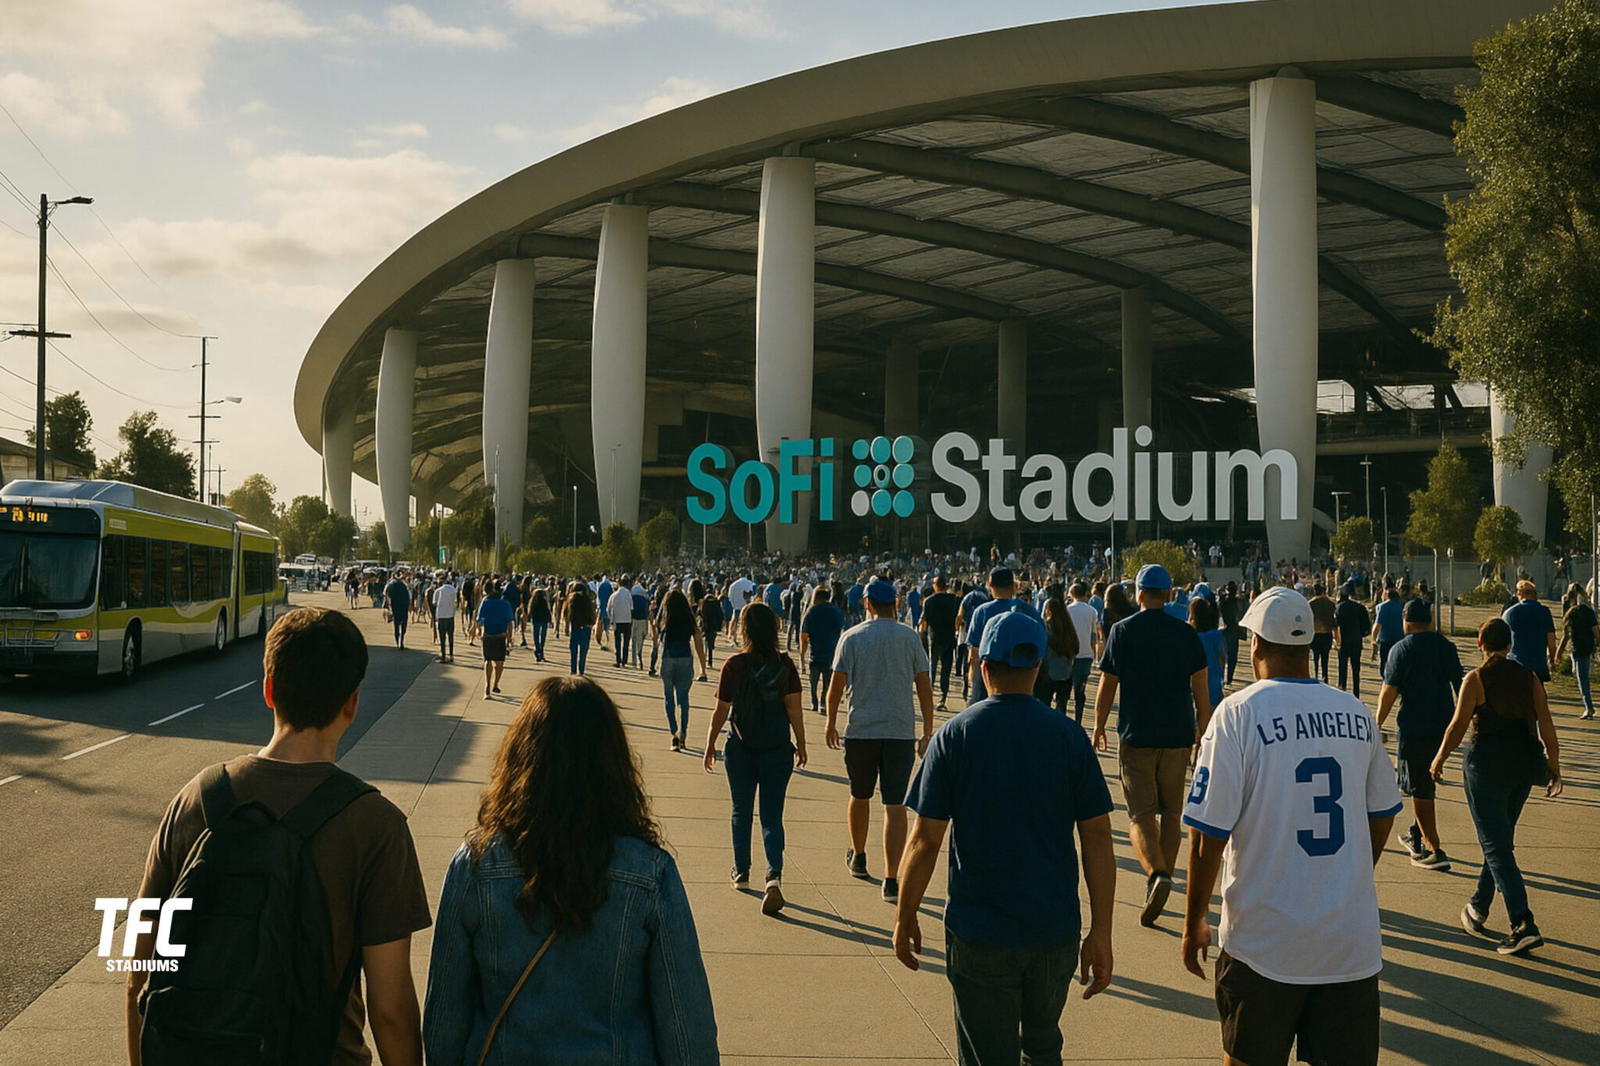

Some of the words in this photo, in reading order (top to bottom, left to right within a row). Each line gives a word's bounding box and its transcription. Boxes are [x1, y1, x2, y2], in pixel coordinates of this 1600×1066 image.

[686, 437, 834, 525] SoFi
[930, 425, 1299, 523] Stadium
[1294, 756, 1345, 857] 3
